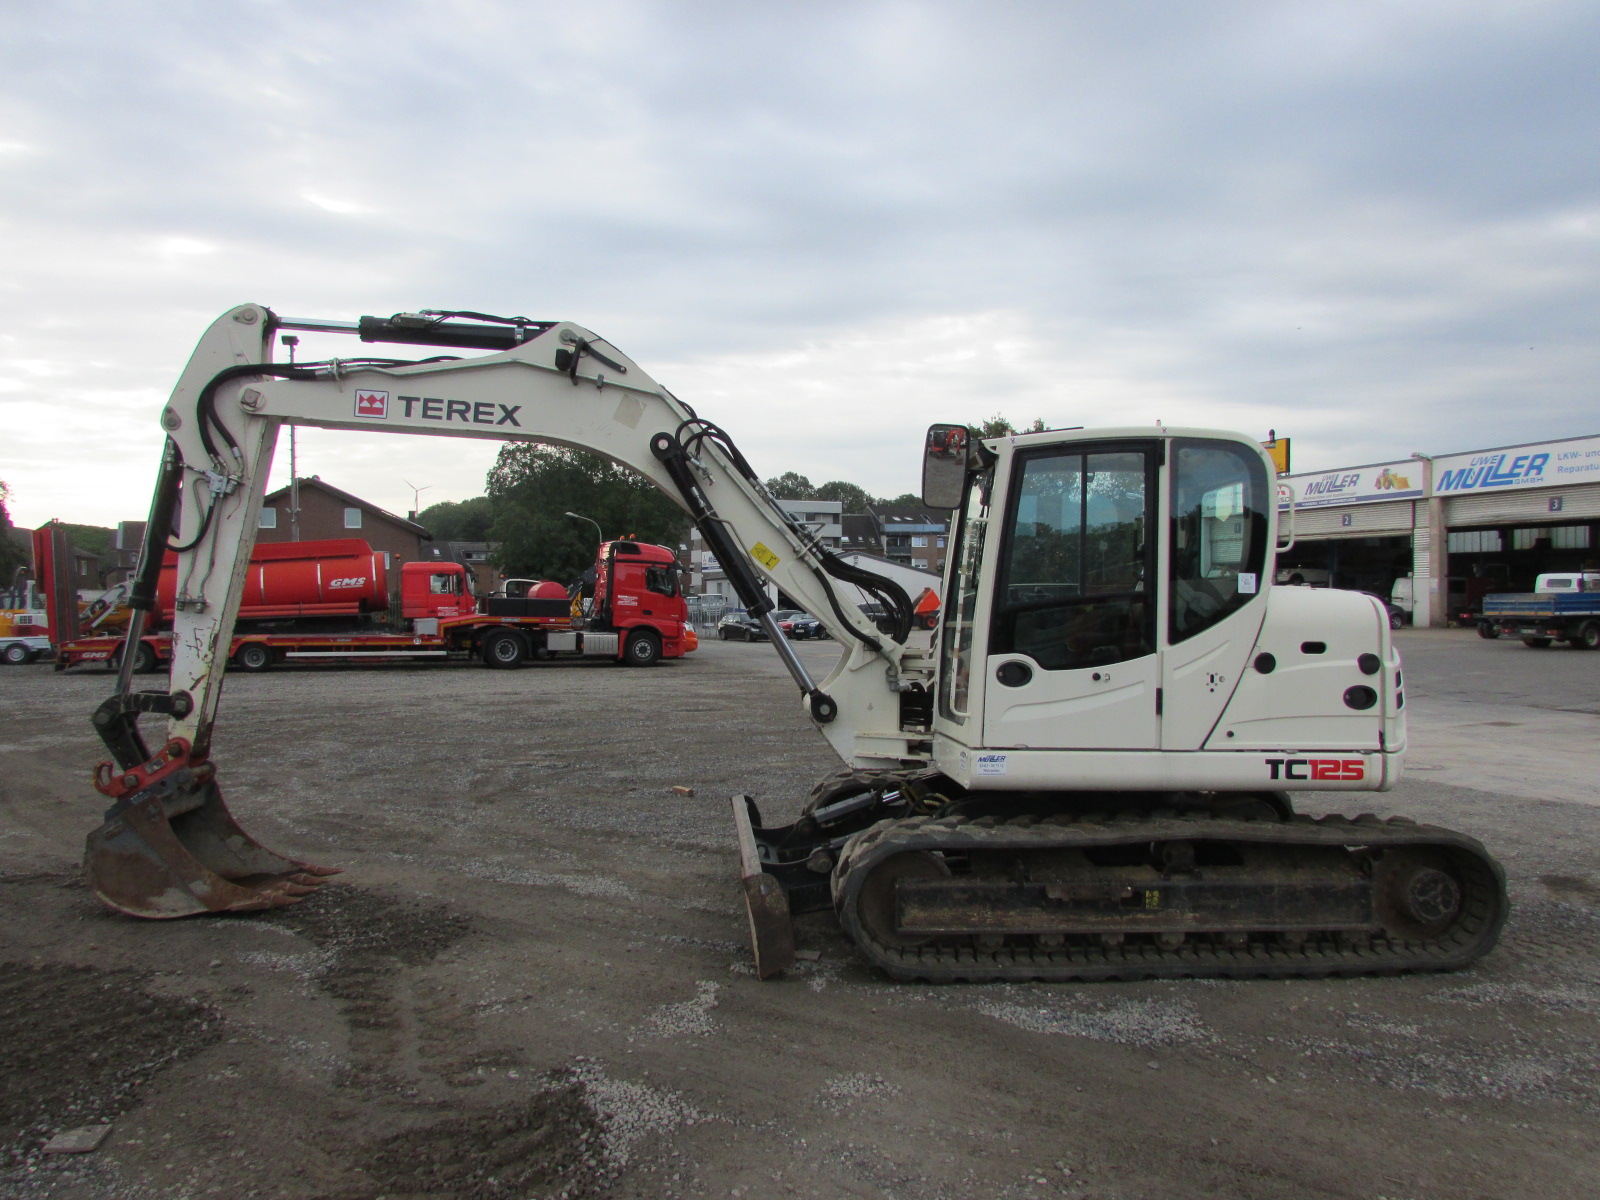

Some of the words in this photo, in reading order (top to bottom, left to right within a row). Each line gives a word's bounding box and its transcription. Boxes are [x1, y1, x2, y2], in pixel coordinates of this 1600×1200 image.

[398, 395, 522, 427] TEREX
[1470, 455, 1498, 466] UWE
[1436, 453, 1550, 491] MÜLLER
[1304, 473, 1360, 495] MÜLLER
[330, 577, 366, 587] GMS
[1265, 759, 1364, 780] TC125
